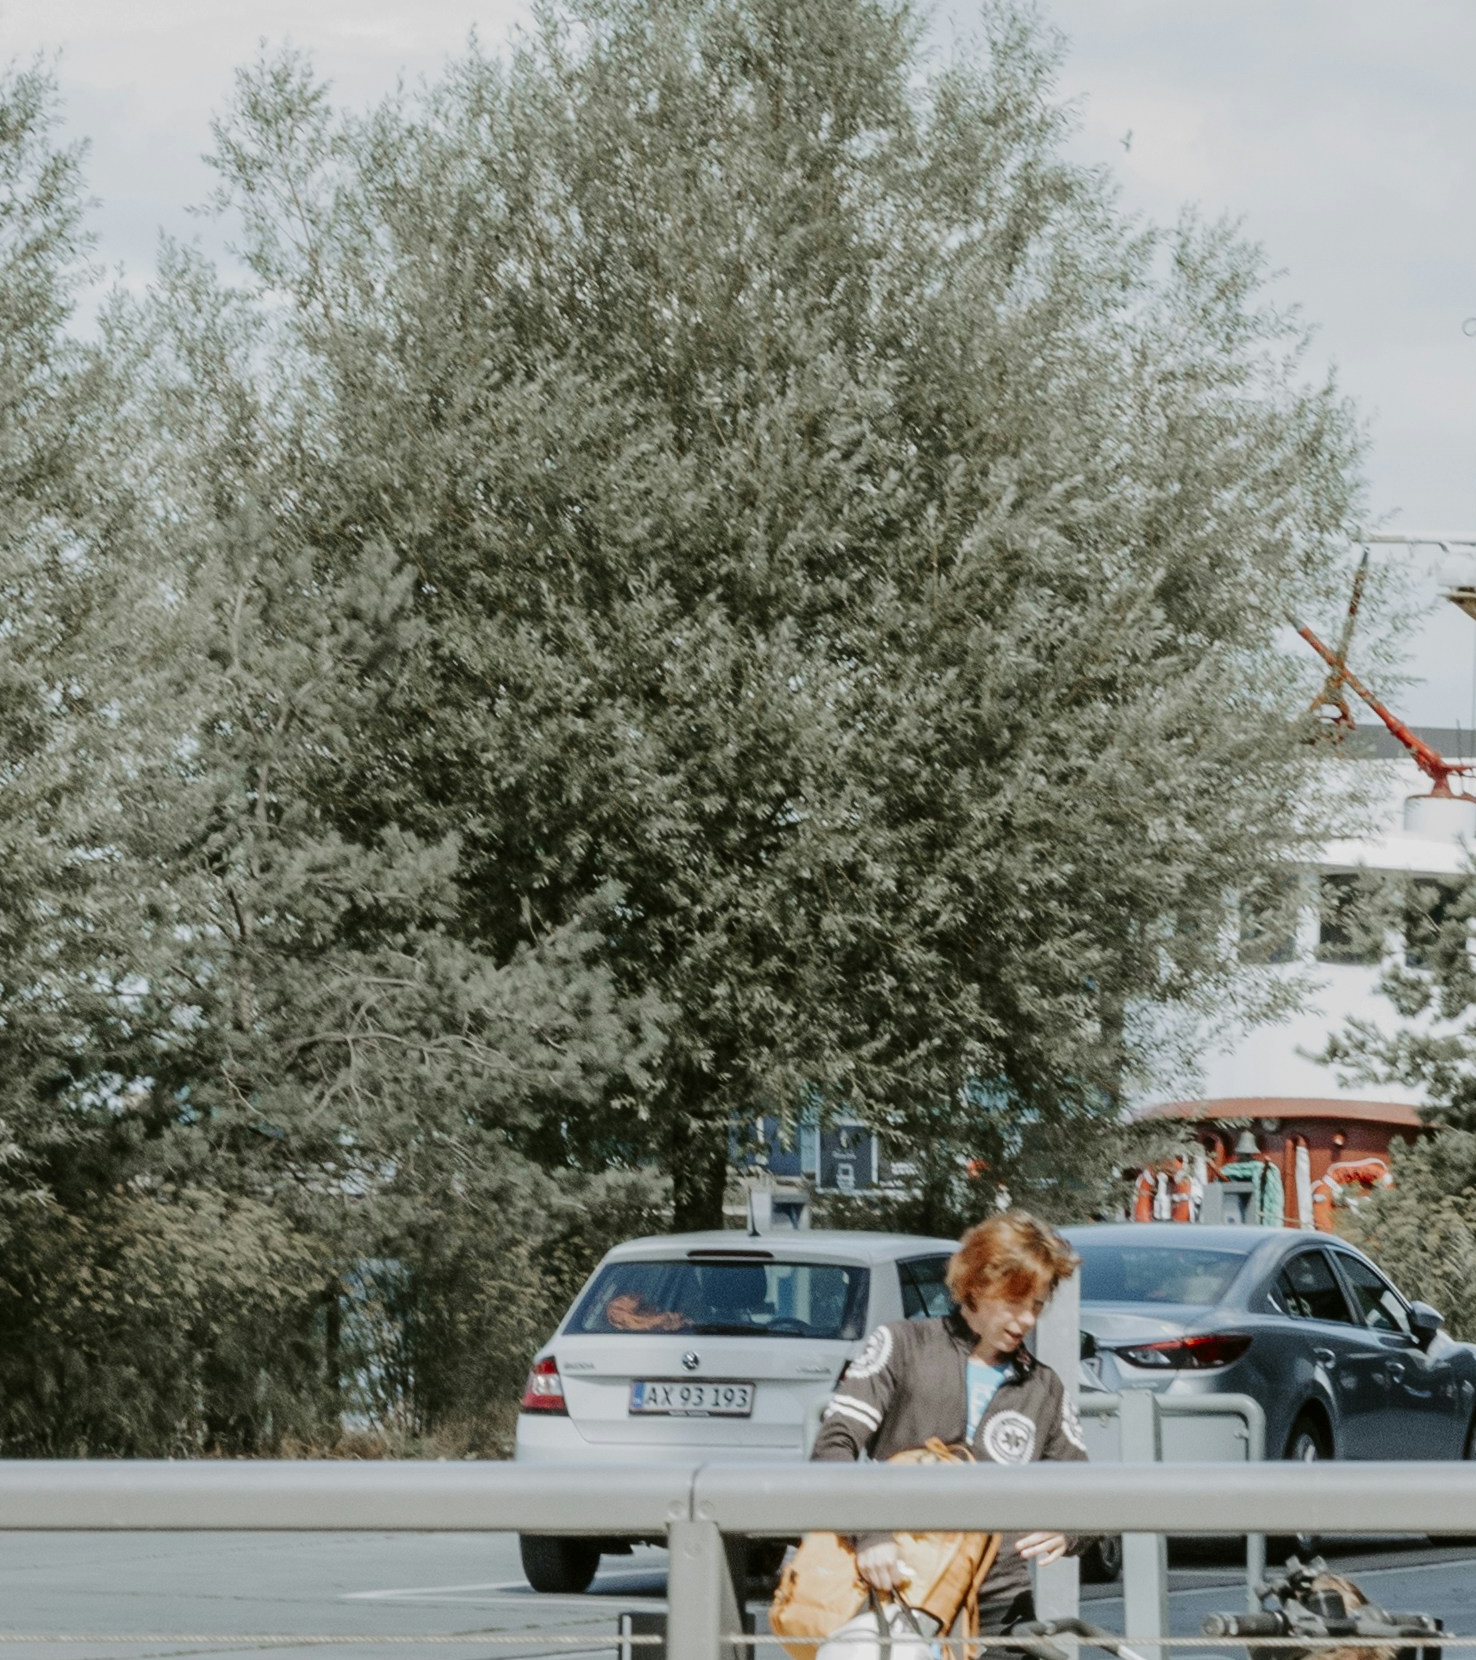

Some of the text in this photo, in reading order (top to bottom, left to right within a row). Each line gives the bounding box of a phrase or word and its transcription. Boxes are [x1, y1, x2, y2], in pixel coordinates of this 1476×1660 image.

[645, 1386, 748, 1408] AX 93 193
